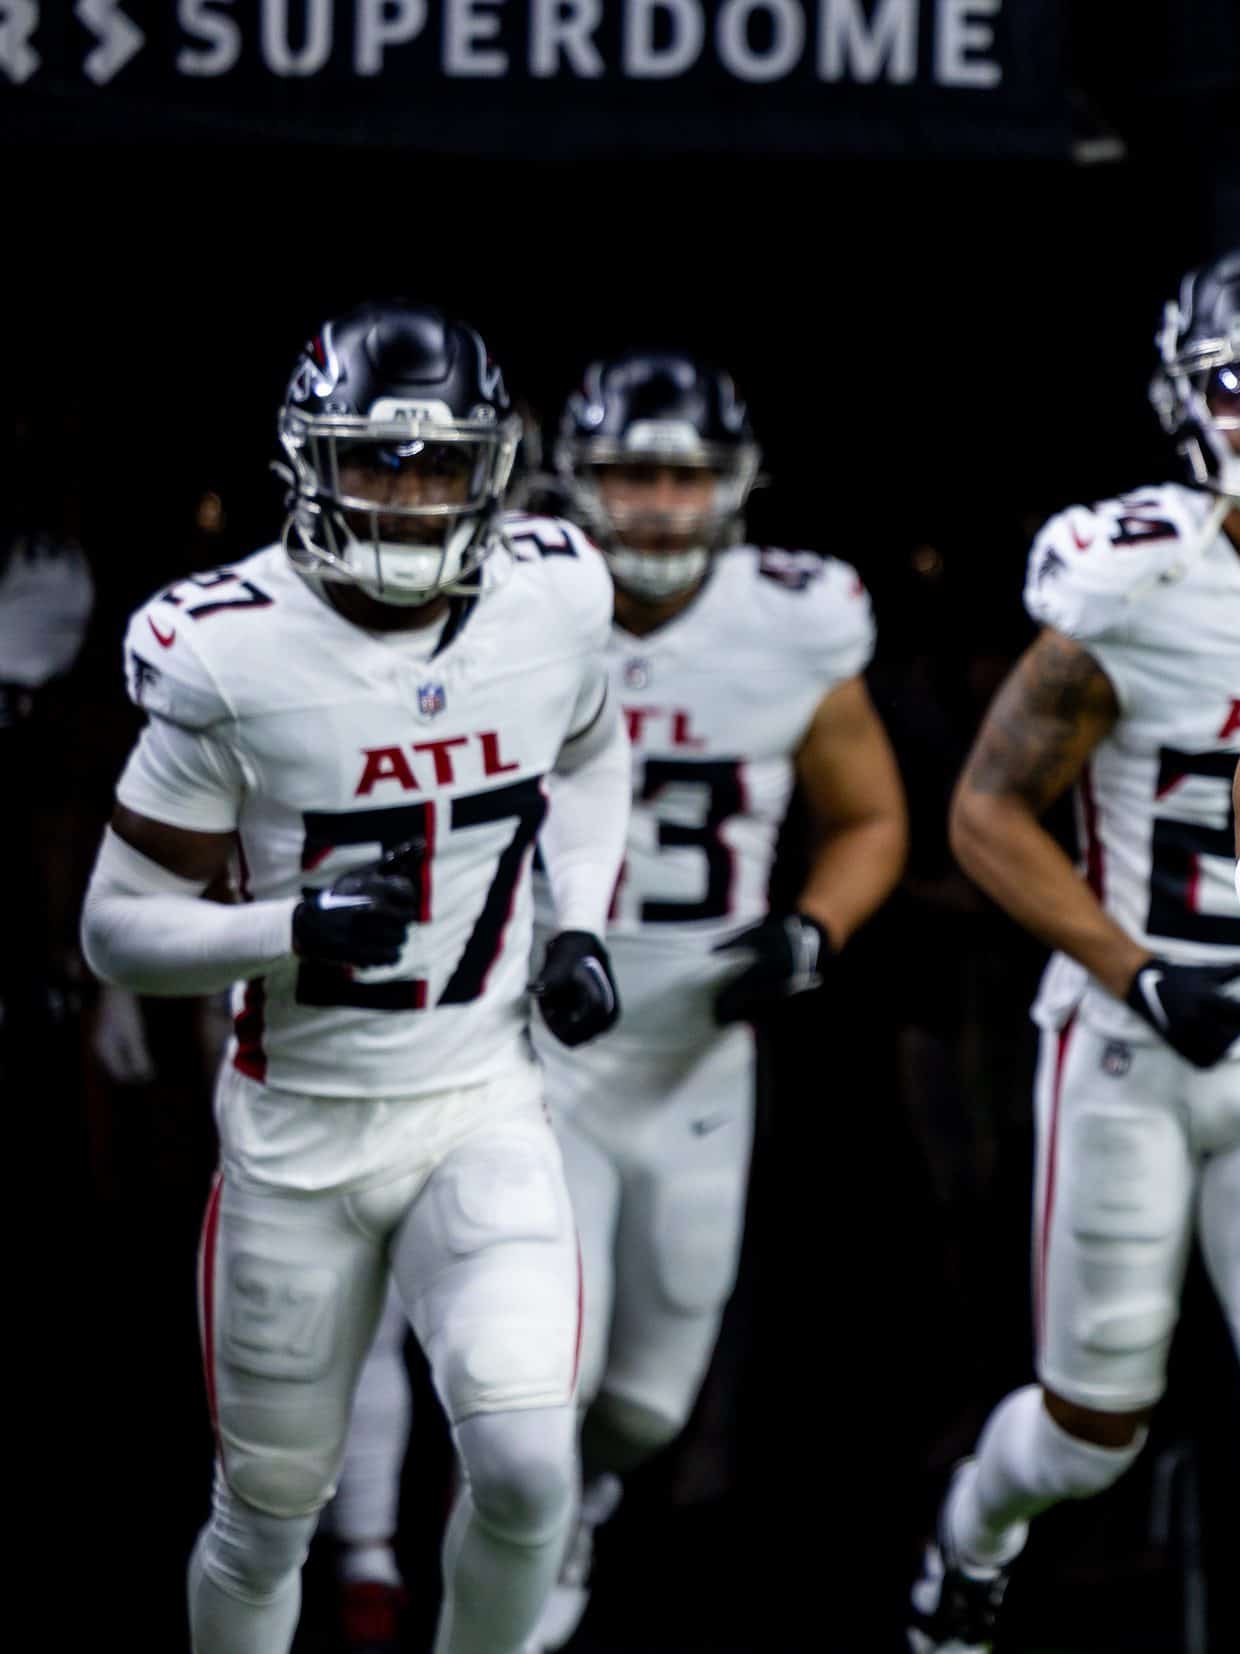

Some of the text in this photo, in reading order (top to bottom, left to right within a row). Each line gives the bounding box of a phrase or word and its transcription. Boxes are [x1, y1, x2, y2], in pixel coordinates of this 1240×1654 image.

[177, 0, 1001, 86] SUPERDOME
[354, 731, 519, 798] ATL
[621, 704, 708, 751] TL
[607, 757, 750, 924] 3
[295, 775, 550, 1010] 27
